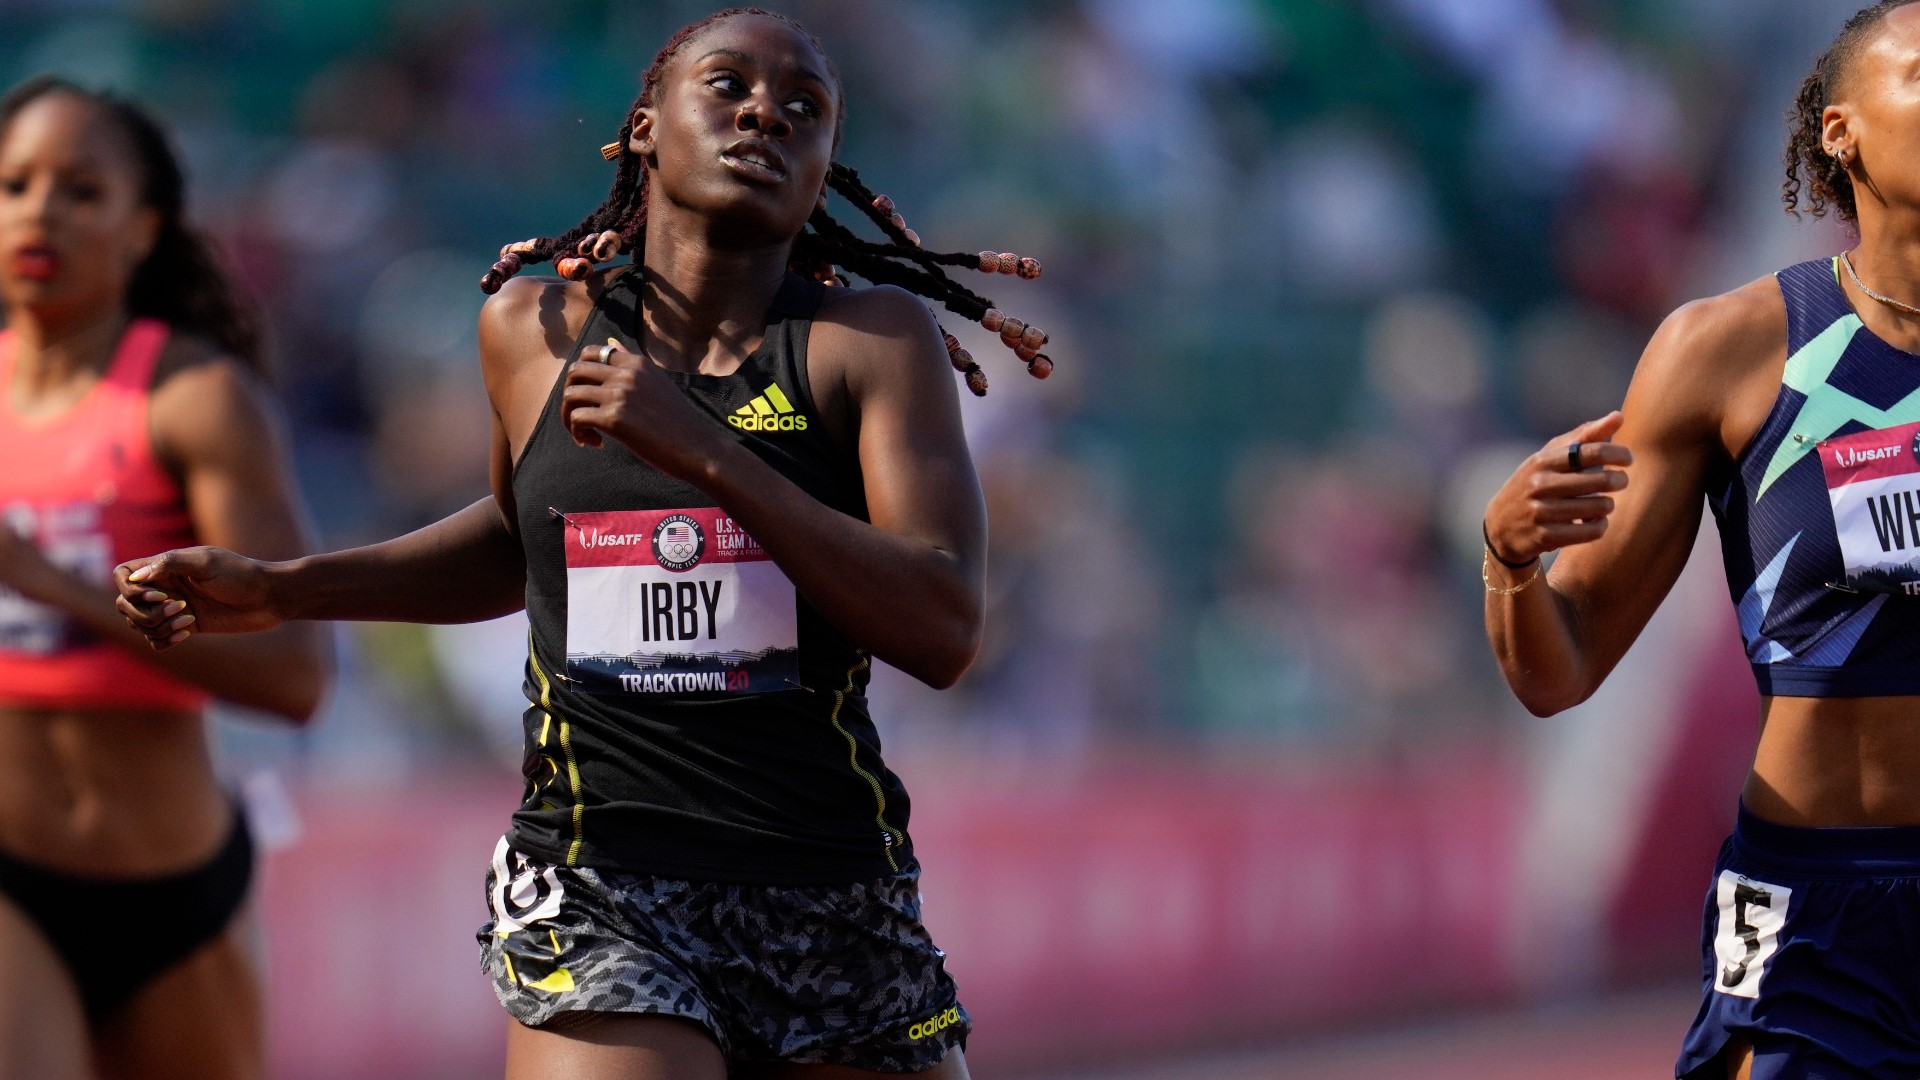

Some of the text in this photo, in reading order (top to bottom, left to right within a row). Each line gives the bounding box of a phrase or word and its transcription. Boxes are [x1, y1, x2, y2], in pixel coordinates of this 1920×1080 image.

[727, 412, 808, 431] adidas
[1857, 445, 1902, 462] USATF
[657, 515, 700, 531] UNITED STATES
[716, 517, 736, 534] U.S.
[598, 533, 643, 546] USATF
[716, 533, 745, 550] TEAM
[717, 549, 739, 557] TRACK
[745, 548, 765, 556] FIELD
[657, 554, 700, 570] OLYMPIC TEAM
[641, 580, 723, 642] IRBY
[1722, 883, 1773, 988] 5
[908, 1006, 960, 1040] adida
